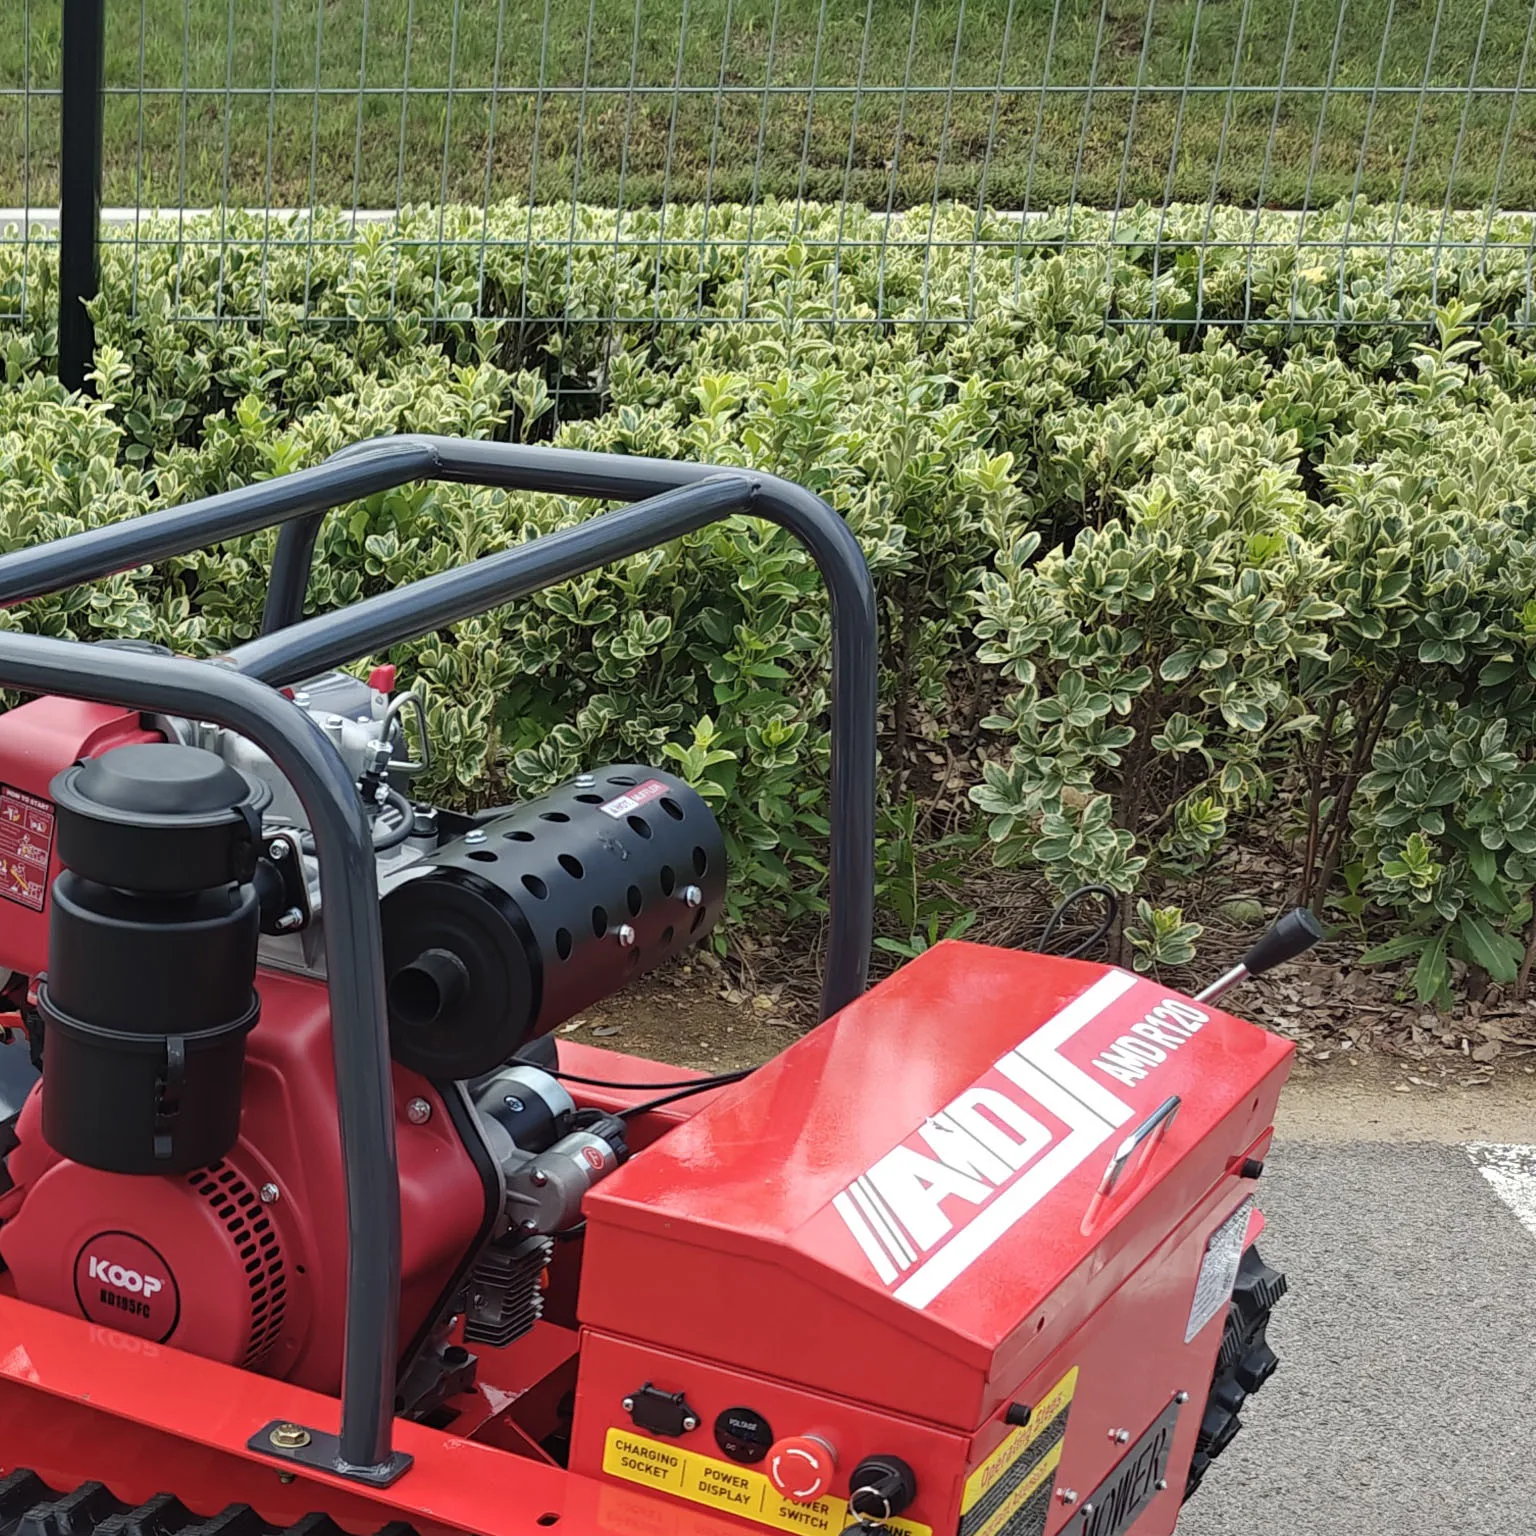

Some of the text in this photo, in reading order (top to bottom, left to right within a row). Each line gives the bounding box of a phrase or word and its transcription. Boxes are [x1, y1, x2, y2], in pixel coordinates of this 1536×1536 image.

[864, 1087, 1054, 1253] AMD
[89, 1255, 162, 1298] KOOP
[729, 1418, 758, 1431] VOLTAGE
[615, 1439, 678, 1468] CHARGING
[620, 1456, 669, 1479] SOCKET
[703, 1467, 749, 1490] POWER
[698, 1481, 751, 1505] DISPLAY
[779, 1506, 829, 1531] SWITCH
